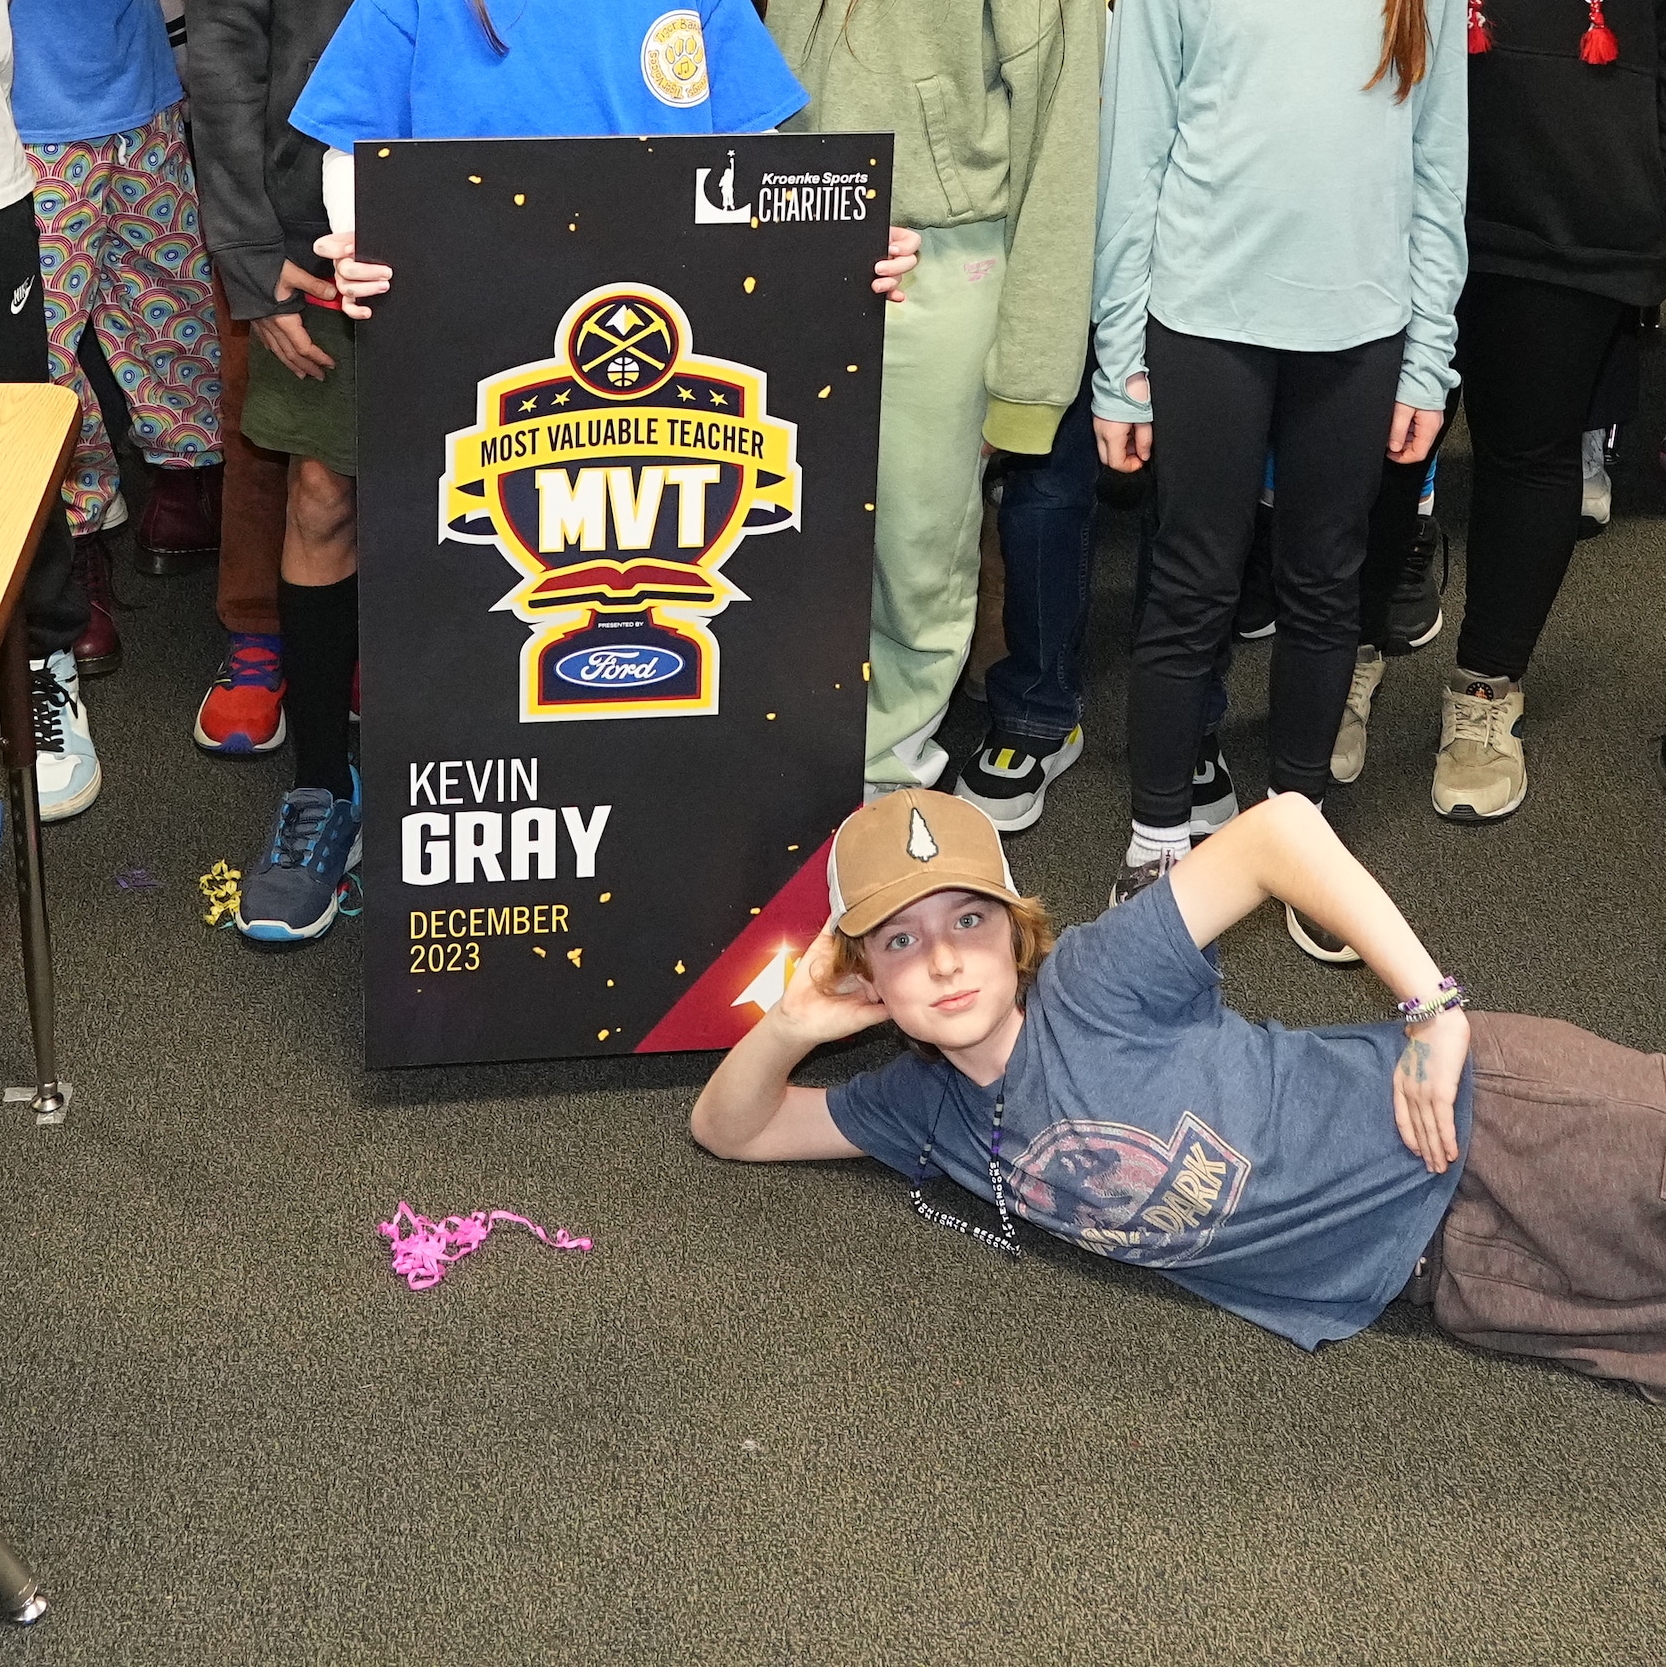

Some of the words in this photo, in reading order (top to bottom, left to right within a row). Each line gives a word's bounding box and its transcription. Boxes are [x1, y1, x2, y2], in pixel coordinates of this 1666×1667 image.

[762, 172, 820, 185] Kroenke
[822, 172, 869, 186] Sports
[758, 186, 867, 222] CHARITIES
[481, 428, 540, 467] MOST
[547, 417, 659, 452] VALUABLE
[667, 419, 765, 459] TEACHER
[534, 464, 721, 554] MVT
[598, 621, 633, 629] PRESENTED
[580, 650, 659, 681] Ford
[409, 757, 538, 807] KEVIN
[401, 804, 612, 887] GRAY
[409, 903, 569, 940] DECEMBER
[409, 942, 481, 974] 2023
[1140, 1141, 1227, 1236] DARK
